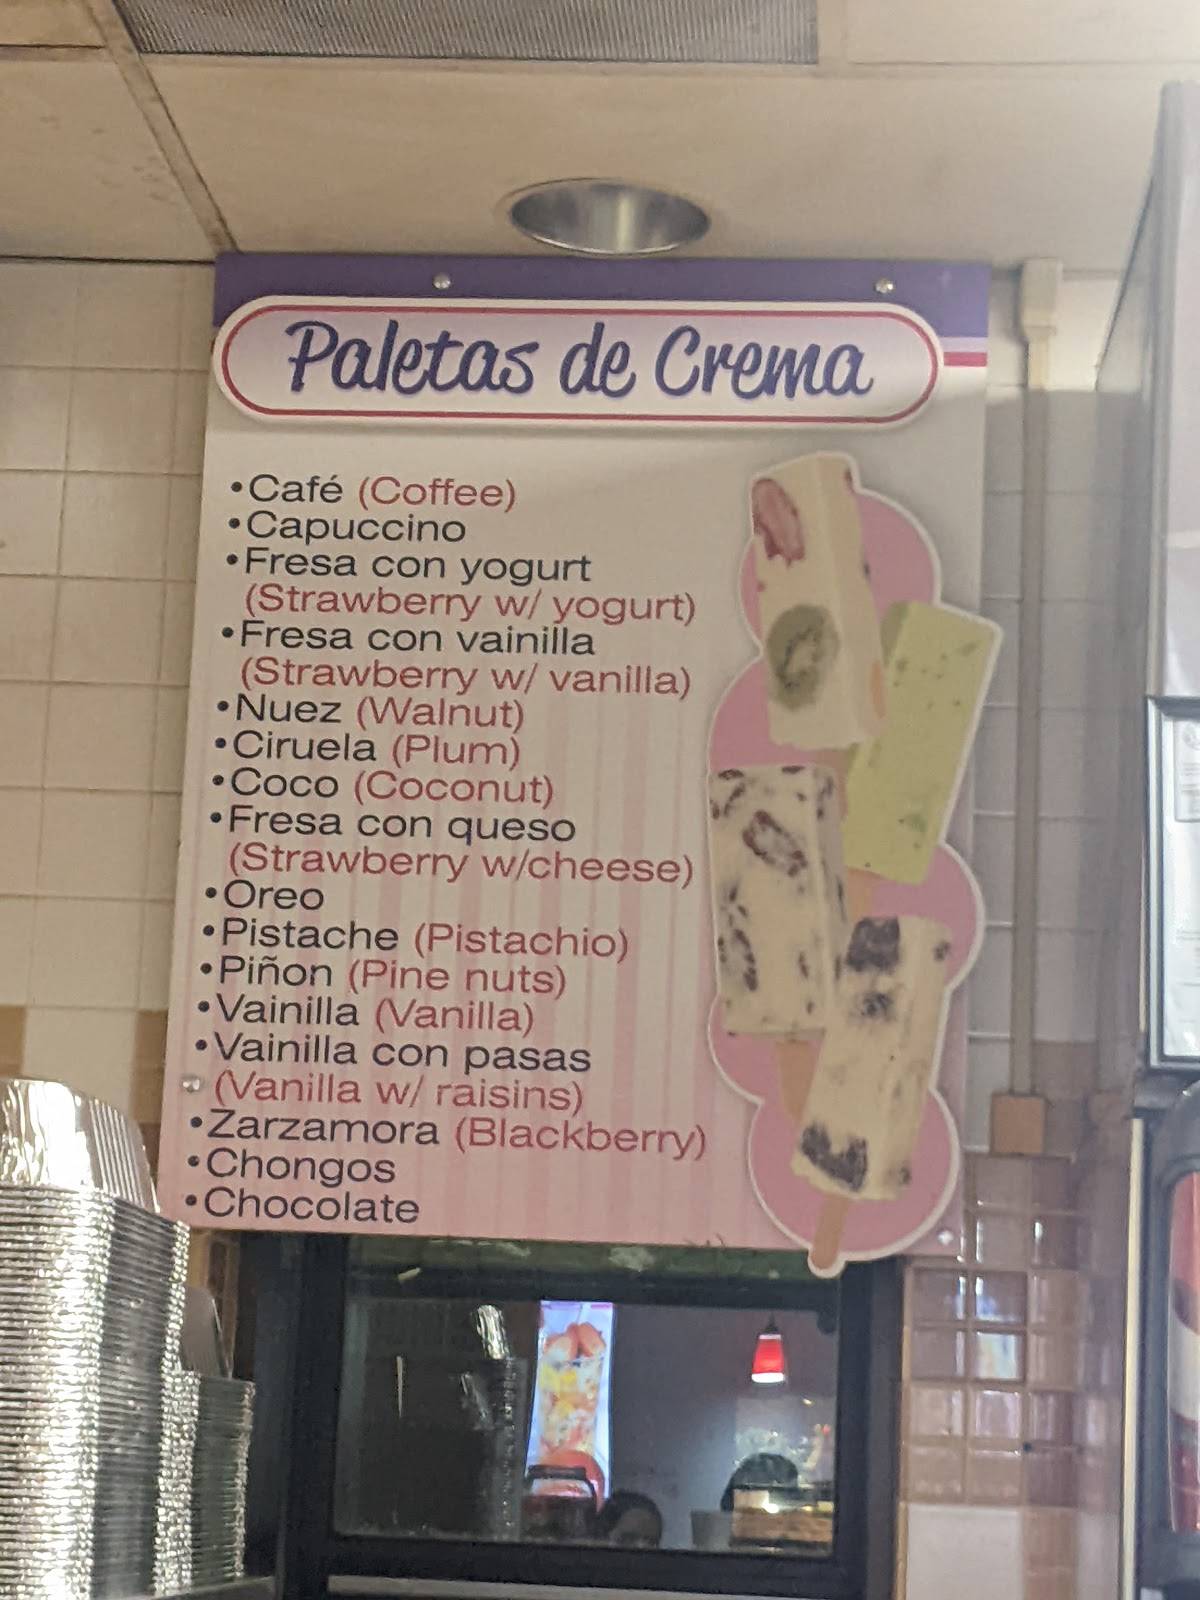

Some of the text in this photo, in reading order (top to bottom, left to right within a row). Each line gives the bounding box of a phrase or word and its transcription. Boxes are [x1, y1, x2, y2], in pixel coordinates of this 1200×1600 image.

[284, 320, 874, 400] Paletas de Crema
[248, 473, 517, 513] Café (Coffee)
[246, 510, 467, 546] Capuccino
[244, 547, 591, 587] Fresa con yogurt
[245, 583, 696, 626] (Strawberry w/ yogurt)
[241, 620, 596, 656] Fresa con vainilla
[241, 656, 692, 698] (Strawberry w/ vanilla)
[235, 693, 525, 731] Nuez (Walnut)
[233, 730, 521, 770] Ciruela (Plum)
[230, 767, 554, 808] Coco (Coconut)
[228, 805, 576, 846] Fresa con queso
[228, 841, 694, 887] (Strawberry w/cheese)
[223, 880, 325, 910] Oreo
[222, 917, 630, 962] Pistache (Pistachio)
[219, 955, 567, 999] Piñon (Pine nuts)
[216, 993, 535, 1036] Vainilla (Vanilla)
[213, 1032, 592, 1075] Vainilla con pasas
[214, 1070, 584, 1115] (Vanilla w/ raisins)
[207, 1108, 708, 1160] Zarzamora (Blackberry)
[206, 1147, 396, 1188] Chongos
[203, 1186, 420, 1224] Chocolate
